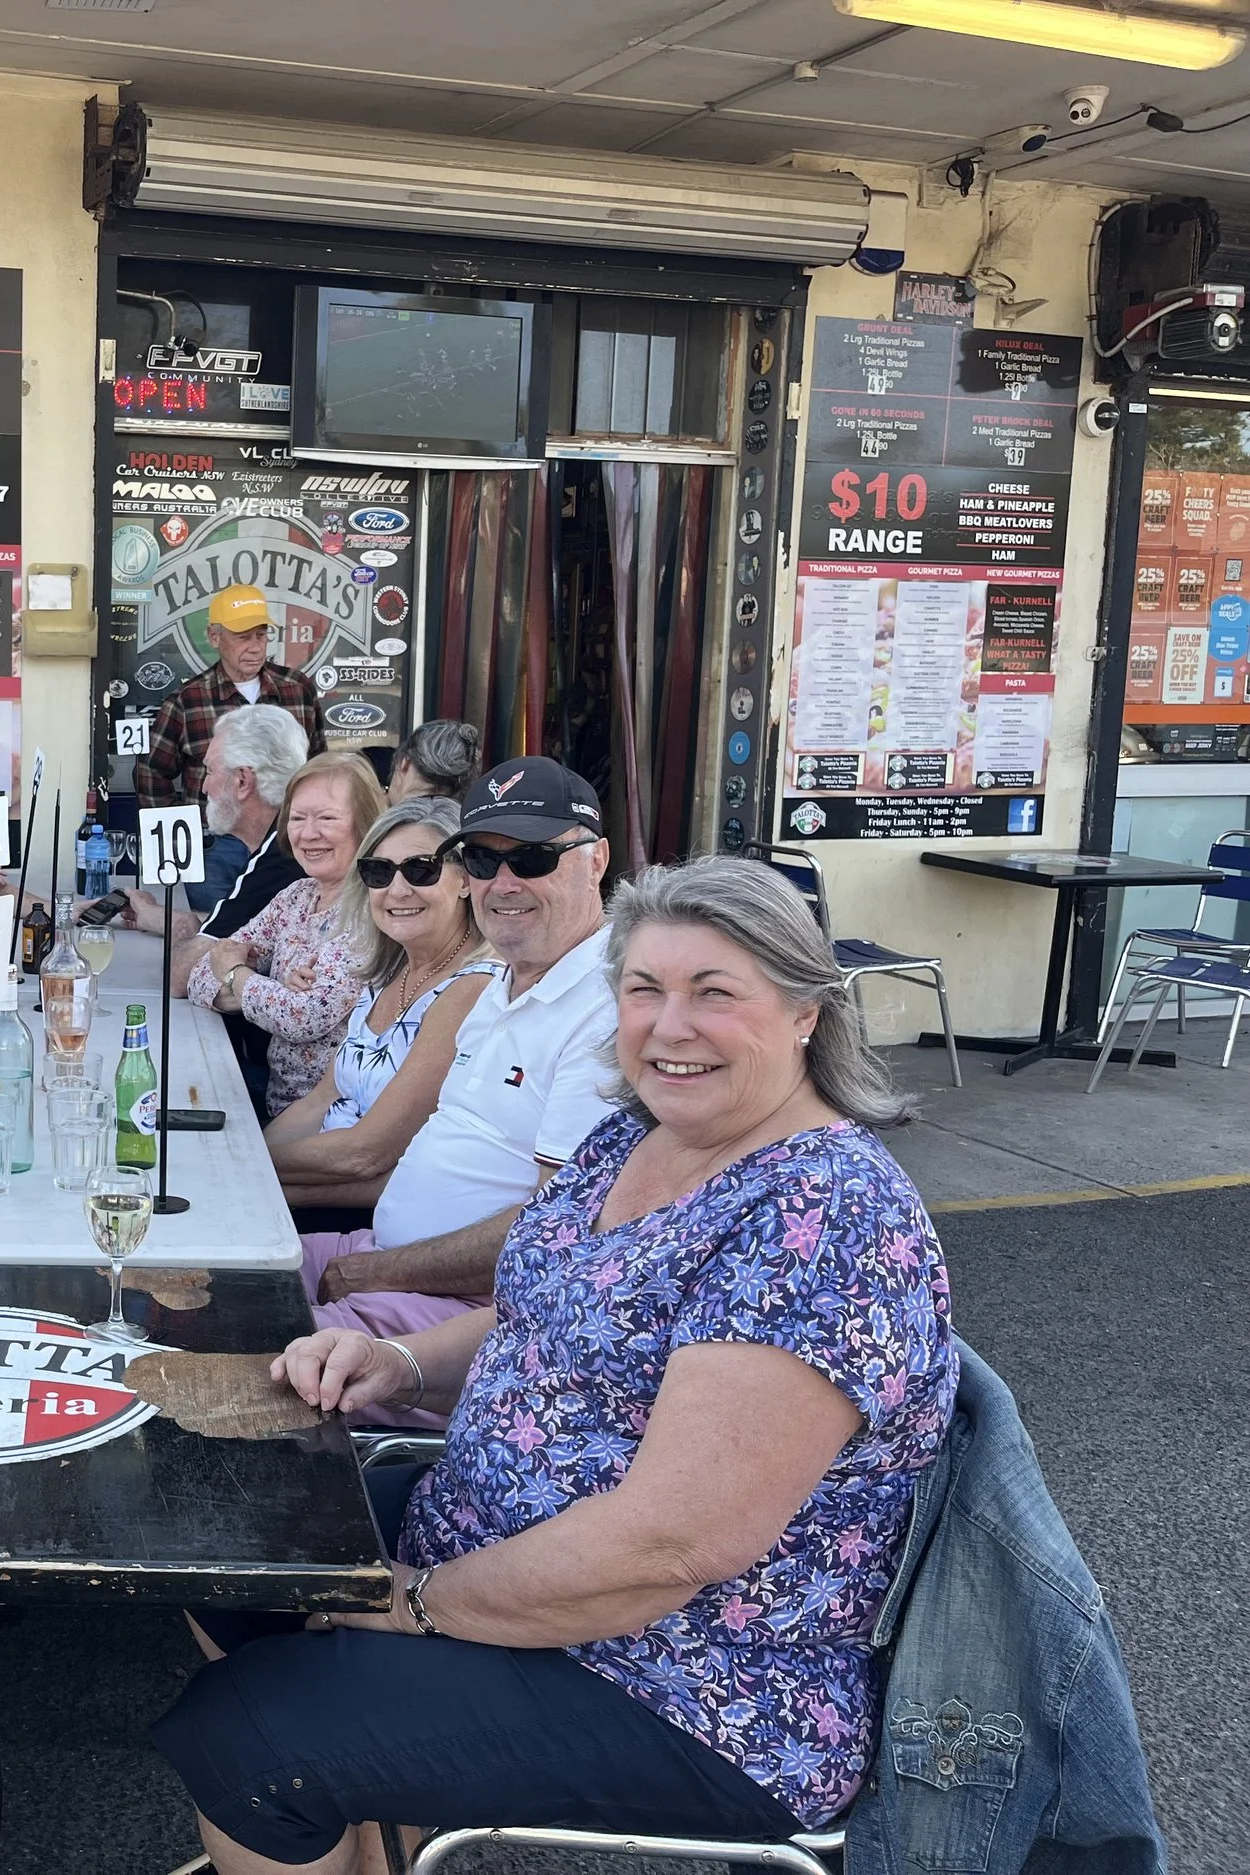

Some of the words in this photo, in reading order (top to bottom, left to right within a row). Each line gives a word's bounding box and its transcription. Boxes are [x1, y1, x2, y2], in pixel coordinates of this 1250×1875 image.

[913, 298, 971, 318] DAVIDSON
[147, 372, 255, 384] COMMUNITY
[114, 379, 207, 409] OPEN
[130, 452, 213, 471] HOLDEN
[260, 455, 298, 469] Sydney
[116, 464, 140, 476] Car
[144, 465, 198, 479] Cruisers
[201, 472, 225, 480] NSW
[232, 472, 283, 483] Ezistreeters
[113, 480, 216, 500] MALOO
[988, 482, 1030, 495] CHEESE
[260, 498, 303, 506] OWNERS
[828, 468, 927, 523] $10
[153, 504, 216, 513] AUSTRALIA
[959, 498, 984, 510] HAM
[997, 499, 1055, 514] PINEAPPLE
[1143, 505, 1170, 514] CRAFT
[1183, 499, 1214, 509] CHEERS
[258, 506, 303, 518] CLUB
[1182, 510, 1212, 521] SQUAD.
[362, 513, 394, 529] Ford
[958, 515, 982, 528] BBQ
[984, 515, 1053, 530] MEATLOVERS
[1145, 515, 1166, 524] BEER
[828, 528, 923, 555] RANGE
[975, 532, 1035, 545] PEPPERONI
[991, 549, 1016, 561] HAM
[153, 550, 361, 621] TALOTTA'S
[115, 591, 147, 600] WINNER
[1174, 634, 1190, 642] SAVE
[987, 650, 1010, 658] WHAT
[1021, 651, 1046, 659] TASTY
[1171, 649, 1199, 663] 25%
[339, 668, 394, 681] SS-RIDES
[1169, 664, 1198, 680] OFF
[338, 707, 371, 723] Ford
[121, 725, 144, 748] 21
[464, 800, 545, 819] CORVETTE
[902, 808, 928, 817] Sunday
[933, 808, 949, 817] 5pm
[954, 808, 970, 816] 9pm
[868, 818, 892, 827] Friday
[893, 817, 917, 826] Lunch
[150, 819, 192, 871] 10
